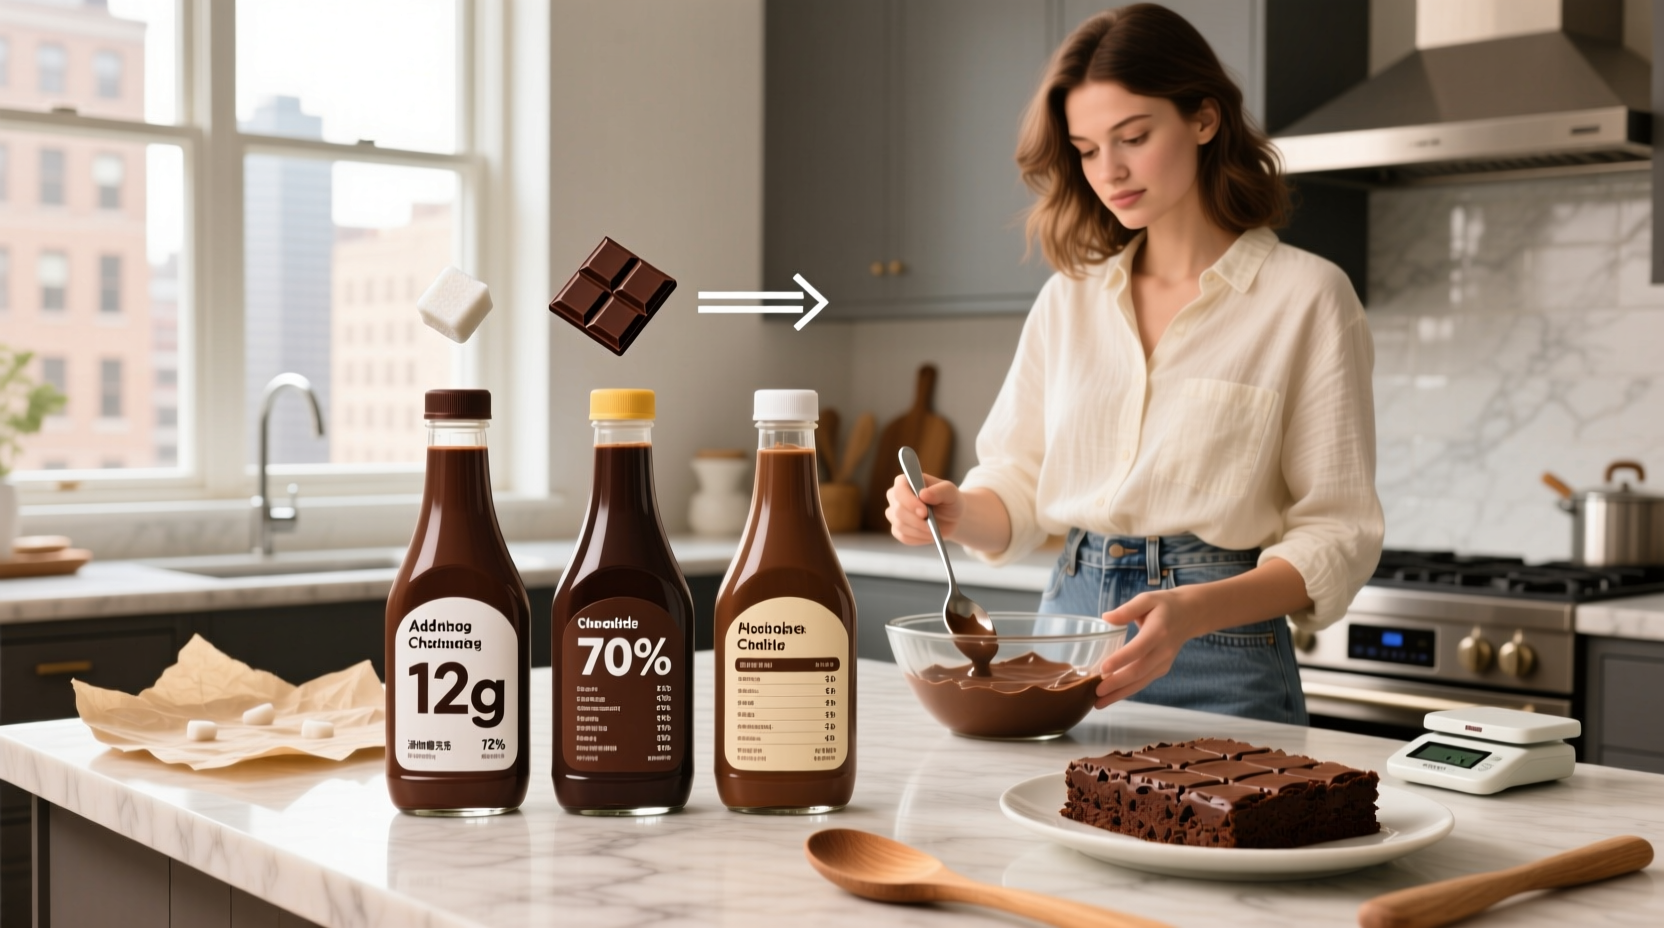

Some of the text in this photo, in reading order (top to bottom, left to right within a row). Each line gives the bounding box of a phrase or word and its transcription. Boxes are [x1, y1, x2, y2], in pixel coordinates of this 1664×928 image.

[577, 637, 672, 677] 70%
[408, 661, 505, 729] 12g
[482, 738, 506, 751] 72%
